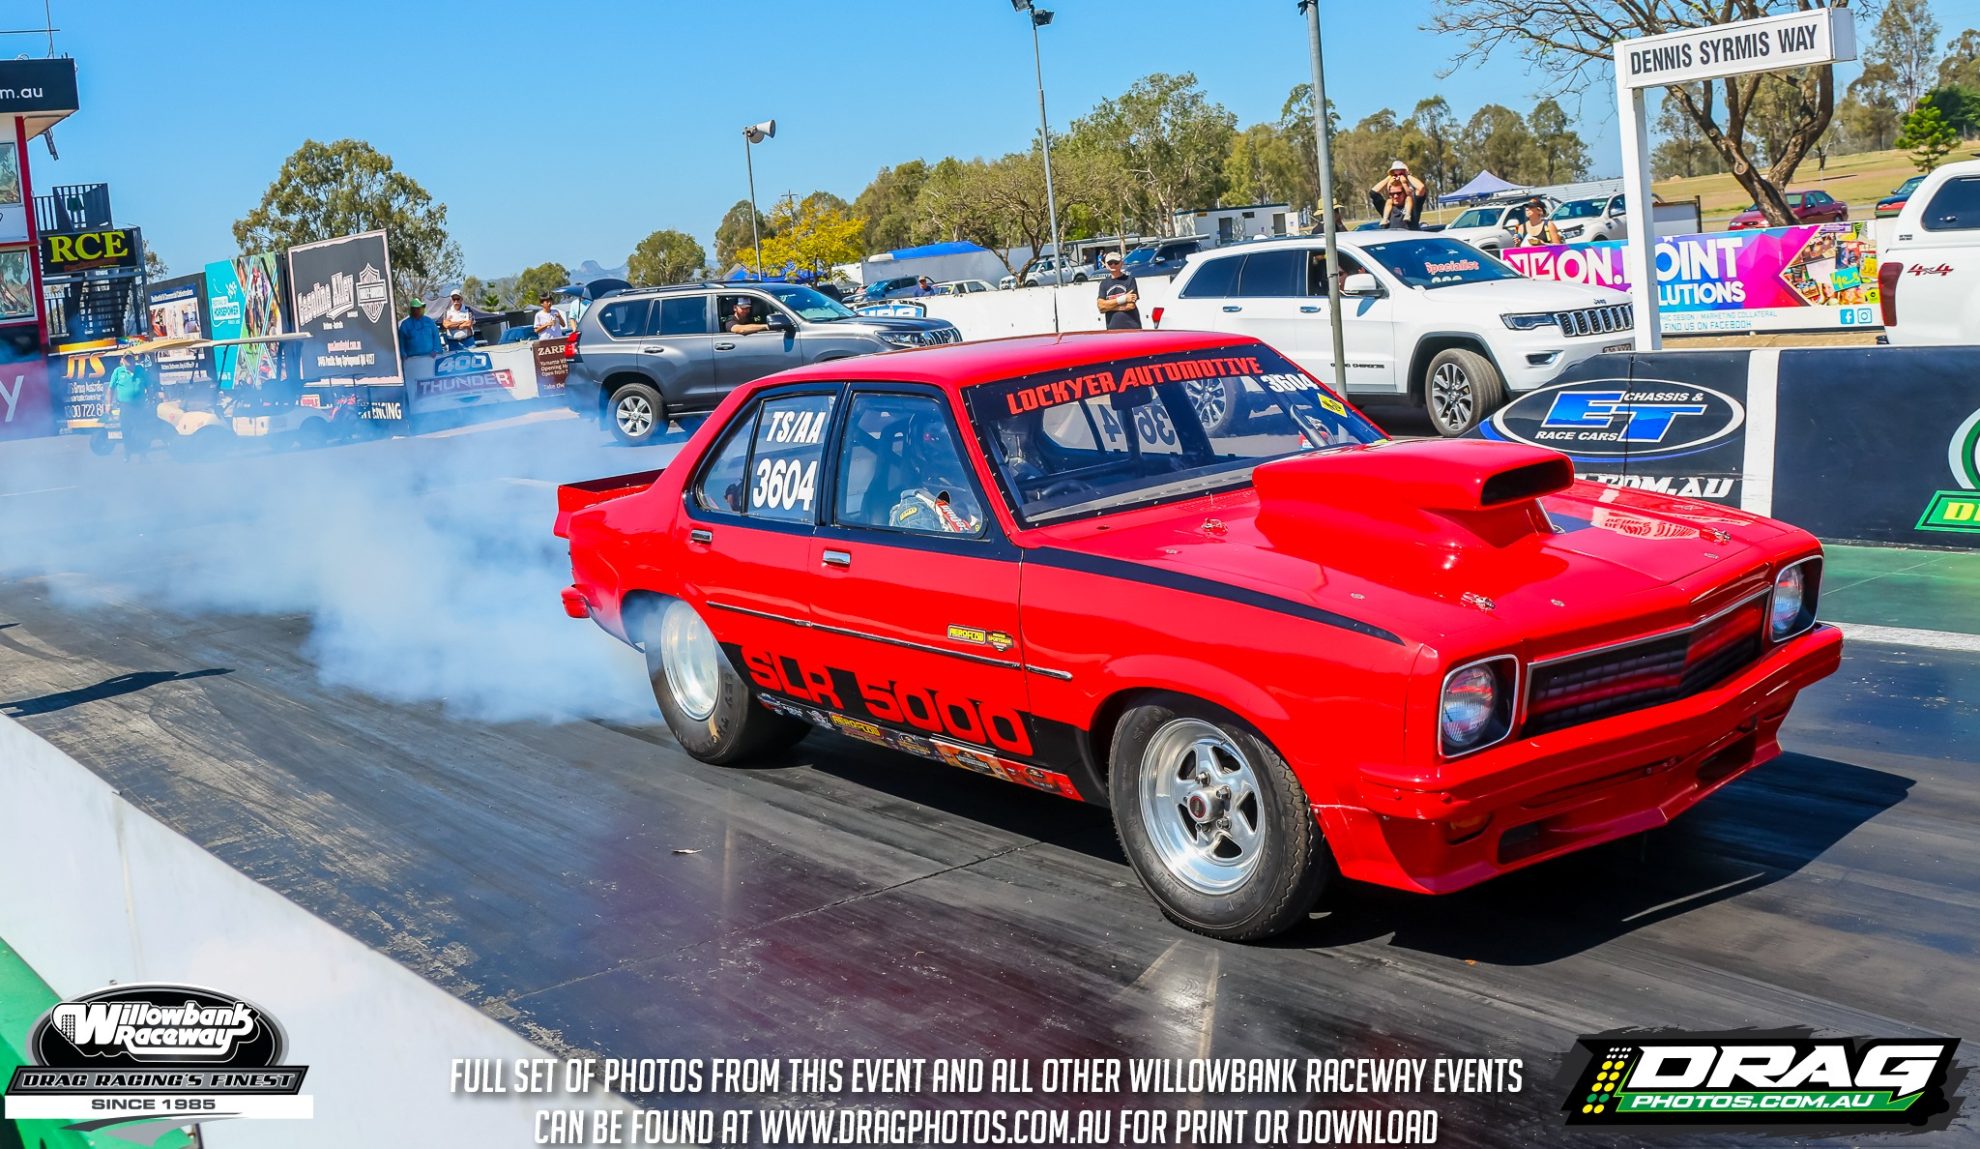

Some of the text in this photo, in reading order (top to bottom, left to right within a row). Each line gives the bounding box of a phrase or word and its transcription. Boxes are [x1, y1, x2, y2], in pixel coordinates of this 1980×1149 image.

[1631, 24, 1818, 75] DENNIS SYRMIS WAY
[49, 231, 129, 263] RCE
[1425, 259, 1480, 275] Specialist
[1556, 237, 1743, 285] ON.OINT
[1907, 262, 1954, 277] 4x4
[1626, 281, 1746, 307] LUTIONS
[1664, 319, 1752, 331] FIND US ON FACEBOOK
[437, 355, 487, 373] 400
[420, 372, 510, 394] THUNDER
[1006, 357, 1263, 415] LOCKYER AUTOMOTIVE
[1261, 373, 1319, 393] 3604
[1623, 391, 1704, 402] CHASSIS &
[766, 411, 826, 444] TS/AA
[1541, 390, 1708, 443] ET
[1535, 431, 1619, 441] RACE CARS
[752, 458, 818, 511] 3604
[949, 627, 985, 642] AEROFLOW
[740, 646, 1034, 757] SLR 5000
